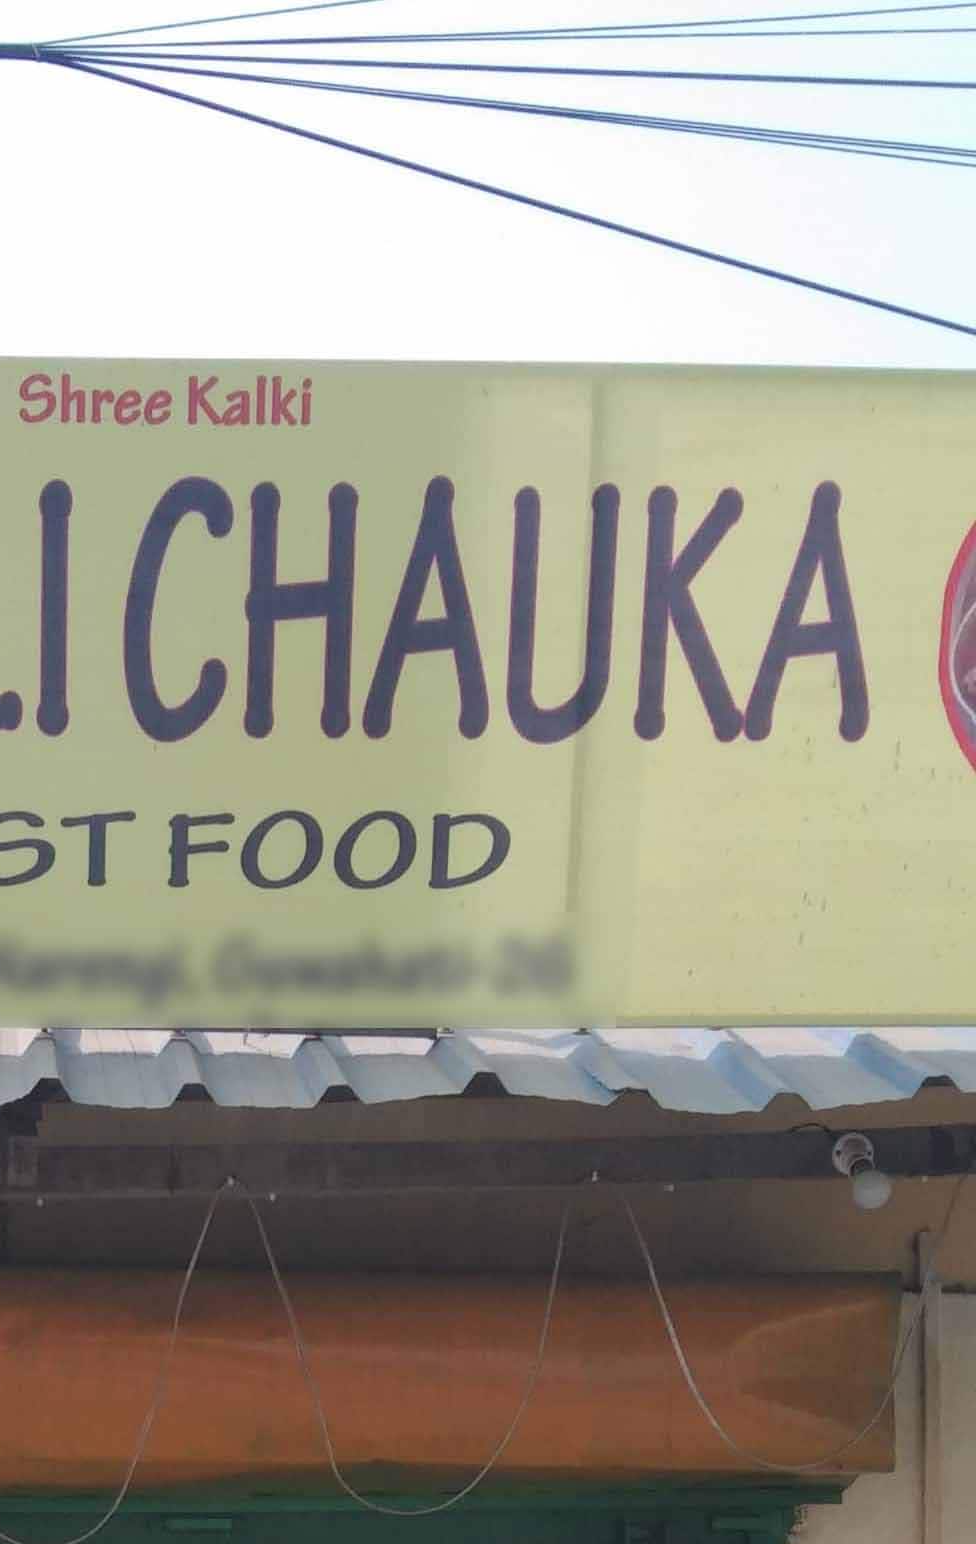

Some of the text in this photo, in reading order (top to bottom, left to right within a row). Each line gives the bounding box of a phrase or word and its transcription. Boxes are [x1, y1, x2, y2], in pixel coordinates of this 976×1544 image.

[18, 373, 313, 427] Shree Kalki
[123, 475, 870, 745] CHAUKA
[167, 810, 512, 890] FOOD
